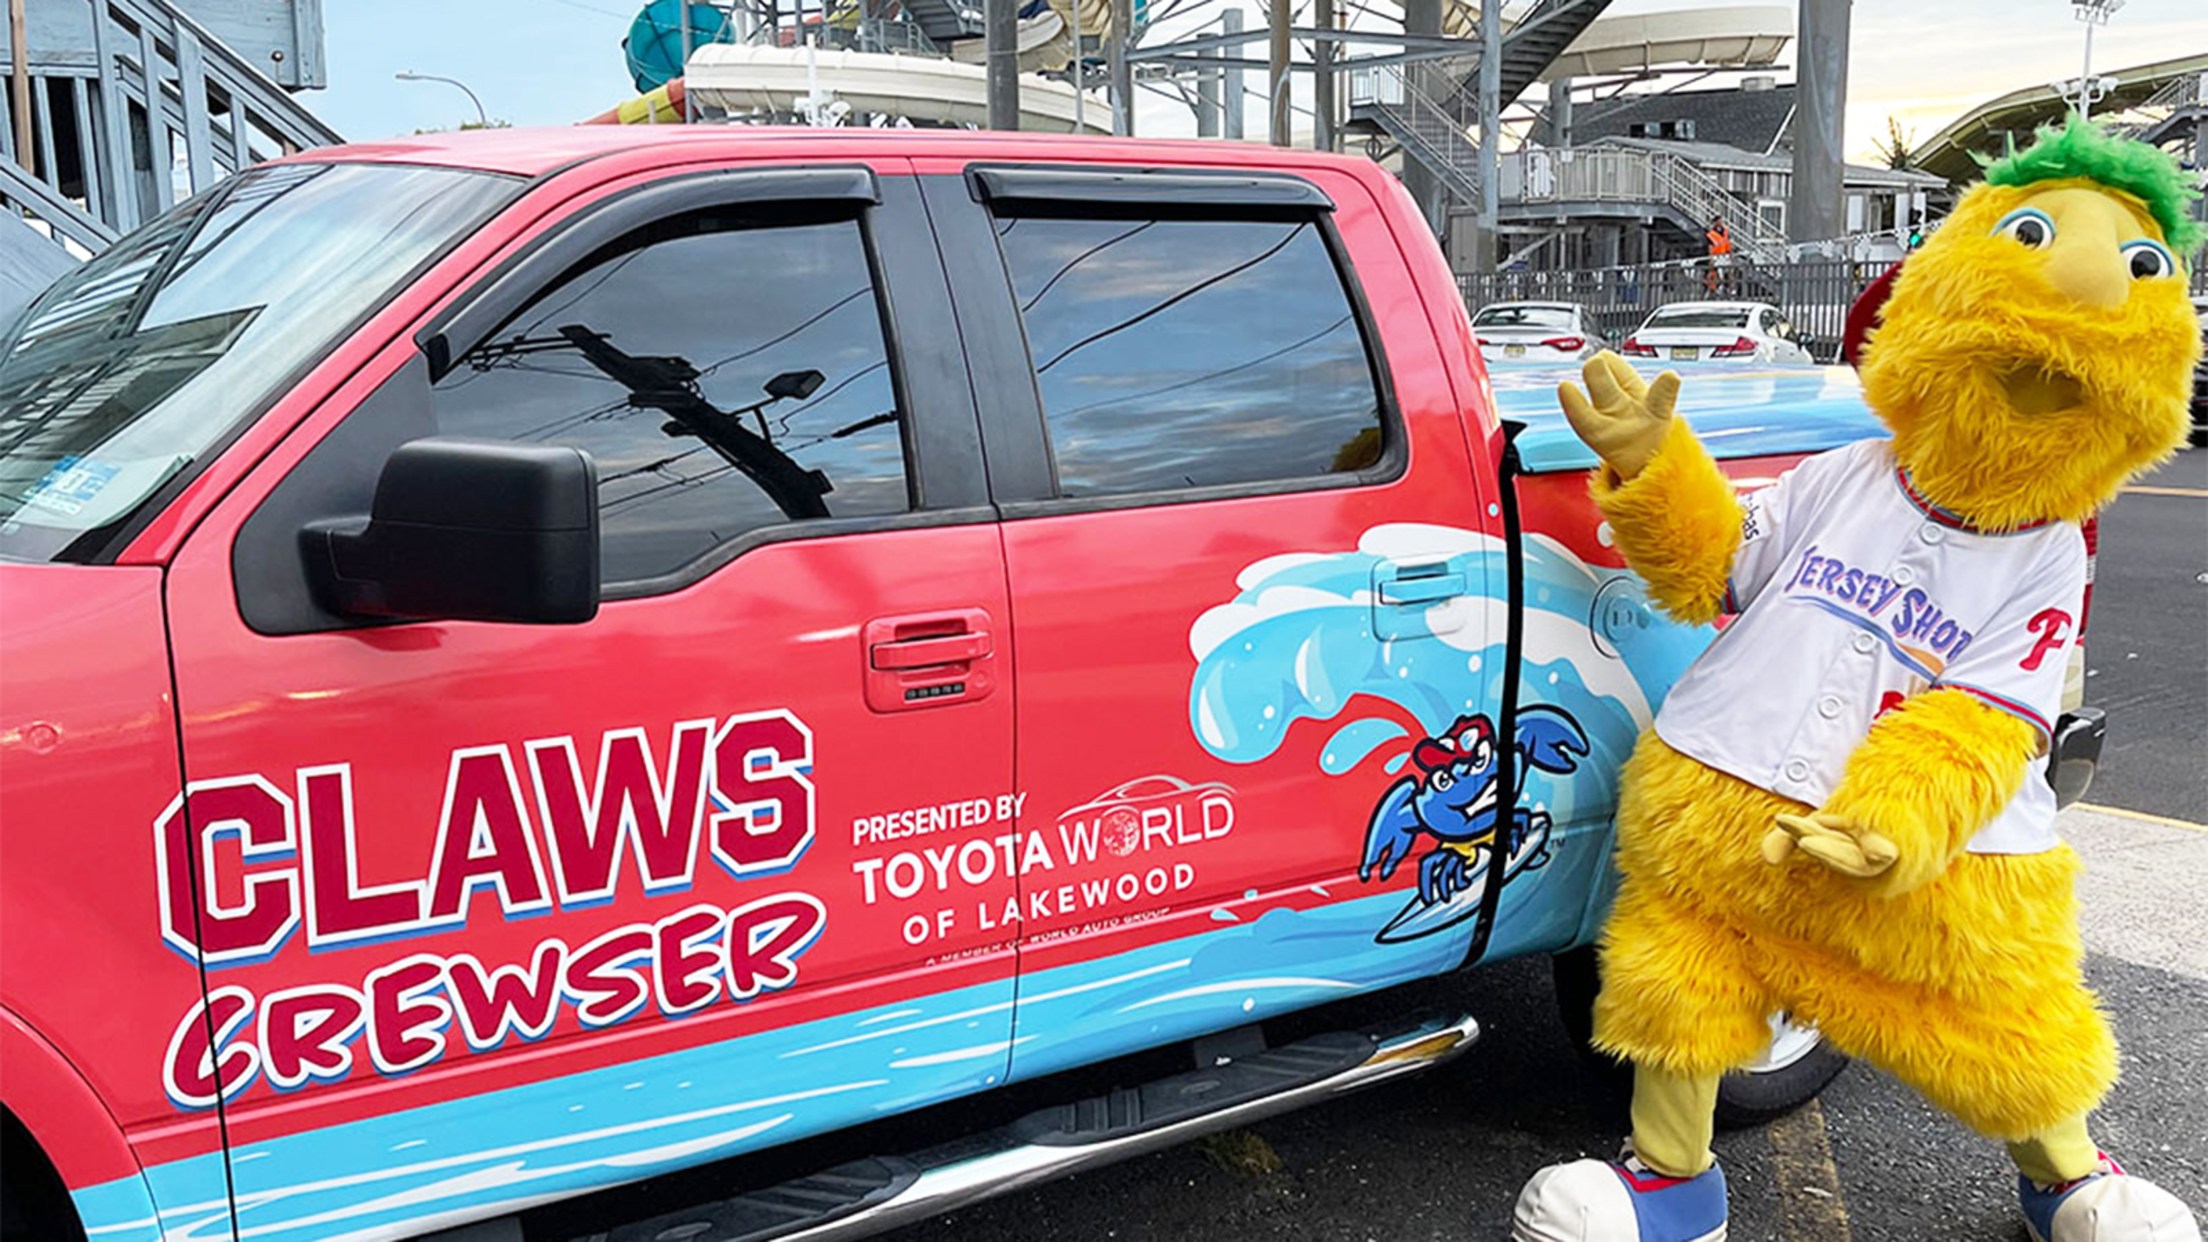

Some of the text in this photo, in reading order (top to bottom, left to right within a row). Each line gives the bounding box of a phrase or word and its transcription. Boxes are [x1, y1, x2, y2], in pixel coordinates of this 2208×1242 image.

[1784, 545, 1902, 617] JERSEY
[2019, 606, 2073, 672] P
[153, 708, 815, 963] CLAWS
[853, 792, 1028, 846] PRESENTED BY
[853, 796, 1235, 904] TOYOTA WORLD
[903, 863, 1195, 945] OF LAKEWOOD
[1030, 926, 1079, 944] WORLD
[1082, 917, 1121, 934] AUTO
[162, 891, 827, 1112] CREWSER
